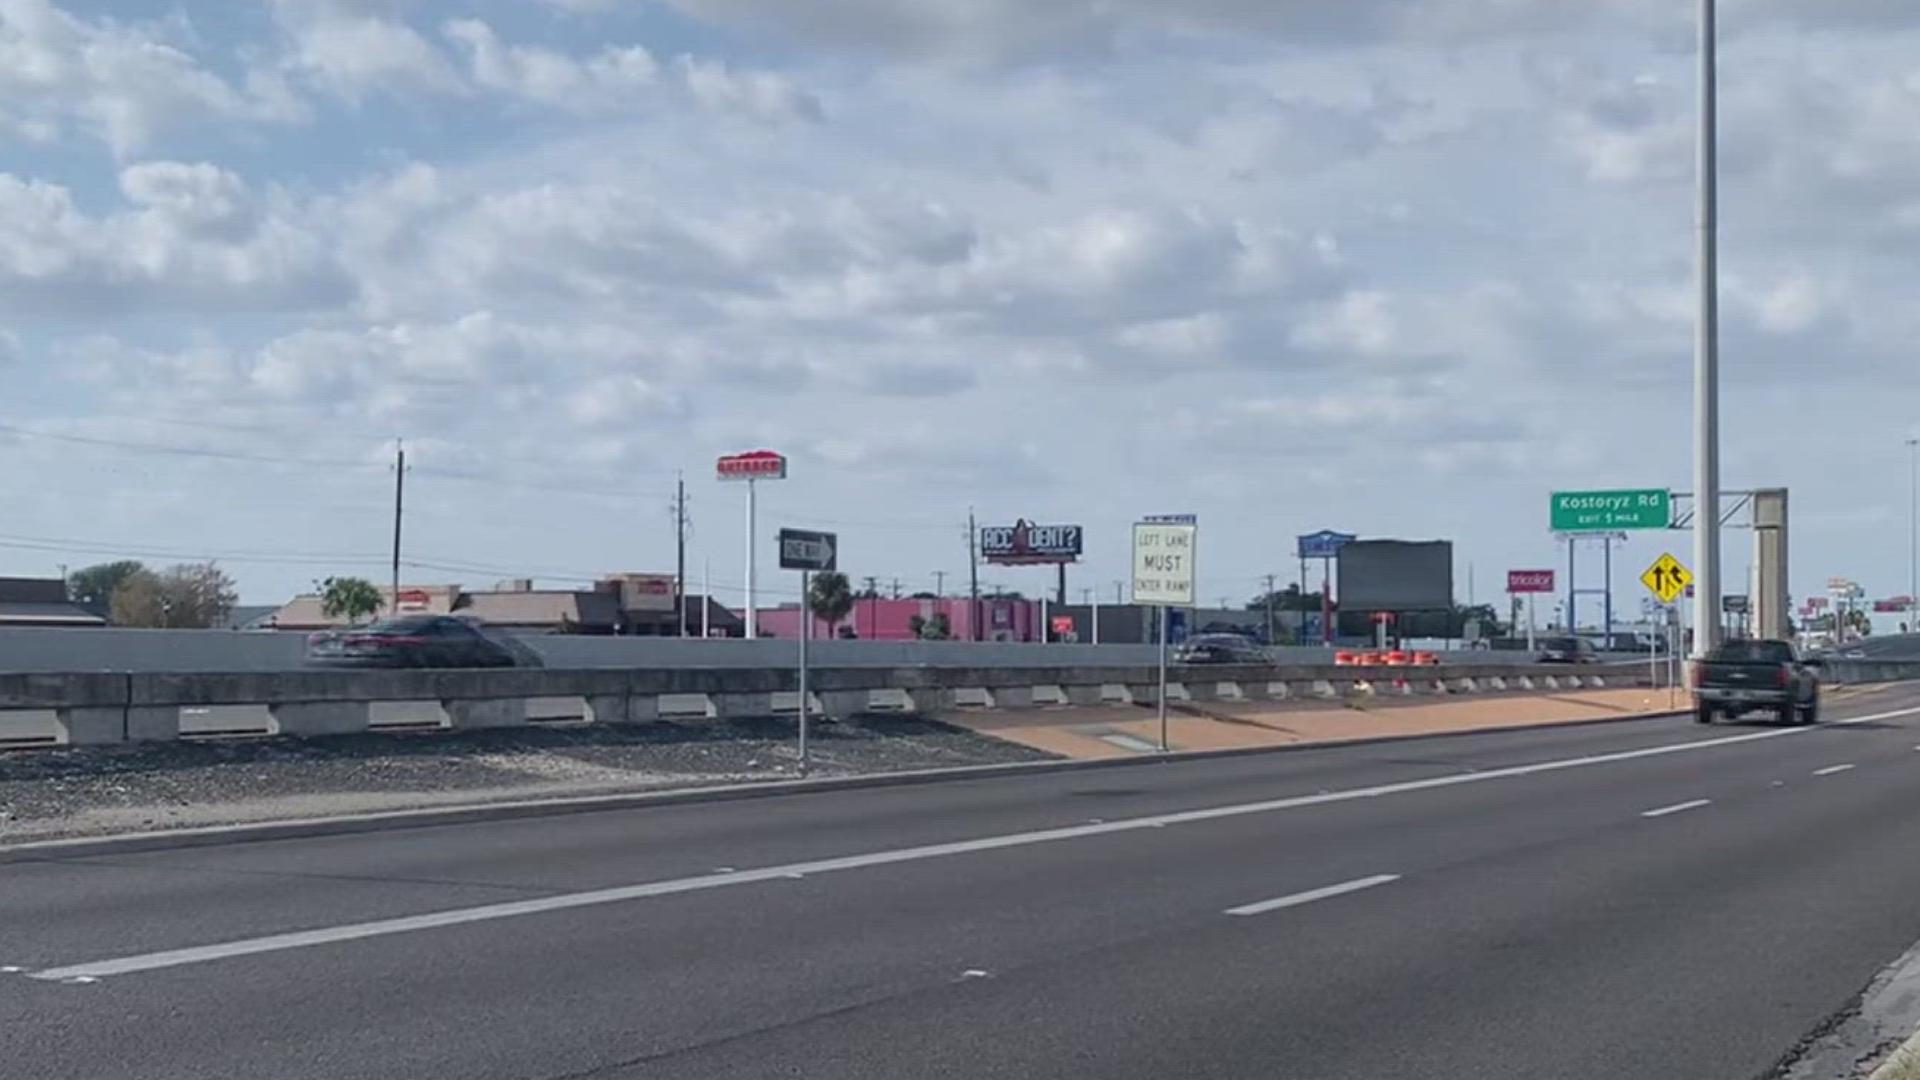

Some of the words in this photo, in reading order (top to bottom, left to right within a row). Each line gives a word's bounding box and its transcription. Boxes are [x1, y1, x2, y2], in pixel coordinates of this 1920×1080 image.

[1560, 496, 1630, 510] Kostoryz
[1637, 494, 1659, 506] Rd
[1578, 514, 1600, 523] EXIT
[984, 528, 1077, 549] ACCDENT?
[1139, 533, 1159, 547] LEFT
[1166, 535, 1188, 548] LANE
[785, 541, 803, 558] ONE
[1144, 554, 1181, 571] MUST
[1136, 578, 1160, 592] ENTER
[1166, 579, 1189, 593] RAMP
